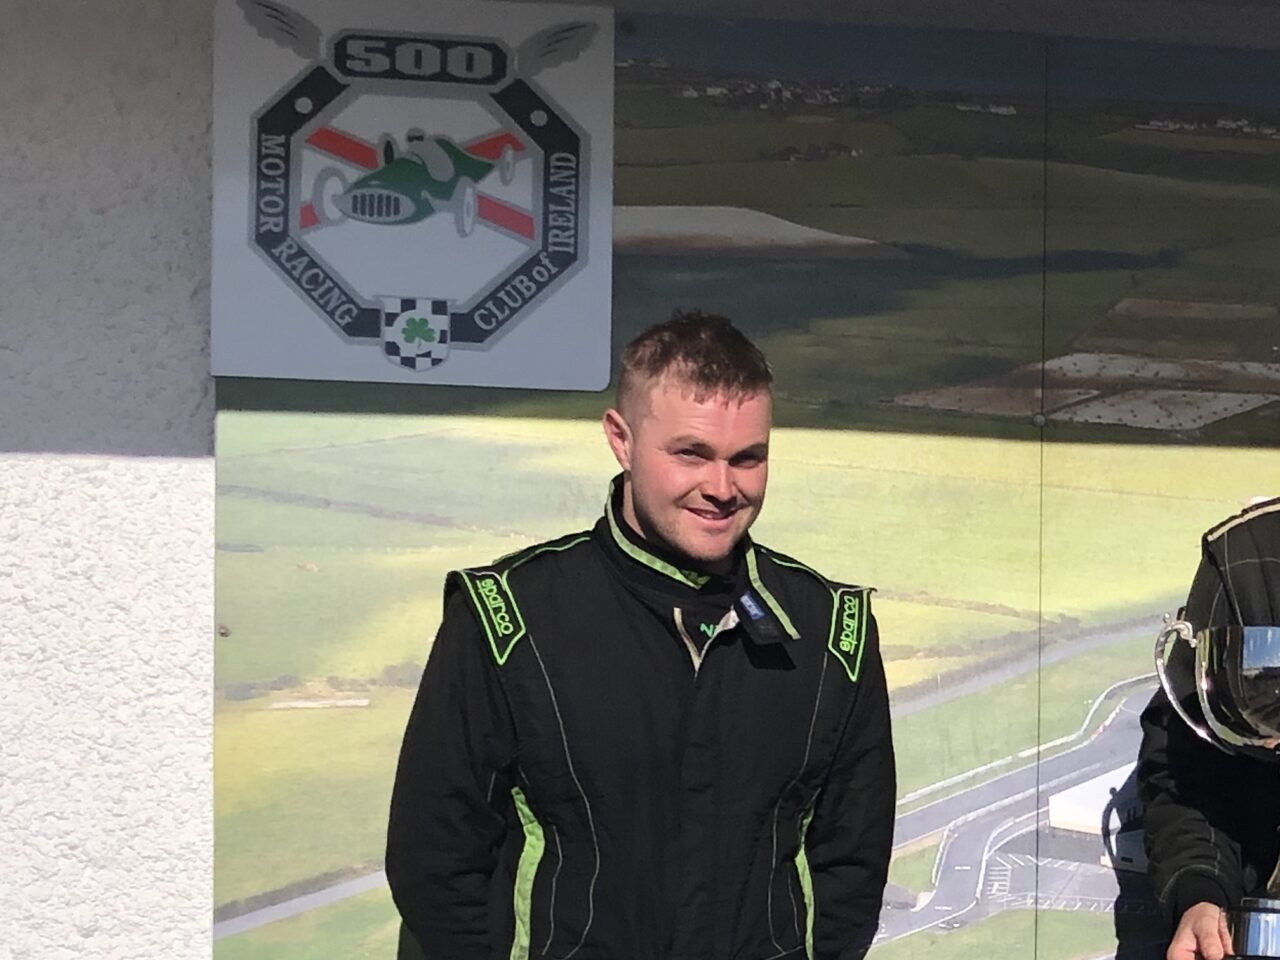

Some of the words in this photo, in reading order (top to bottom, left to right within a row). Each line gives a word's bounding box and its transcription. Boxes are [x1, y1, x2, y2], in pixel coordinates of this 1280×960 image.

[346, 39, 493, 78] 500
[259, 132, 285, 235] MOTOR
[271, 238, 359, 328] RACING
[473, 276, 537, 332] CLUB
[532, 251, 560, 283] of
[549, 152, 577, 255] IRELAND
